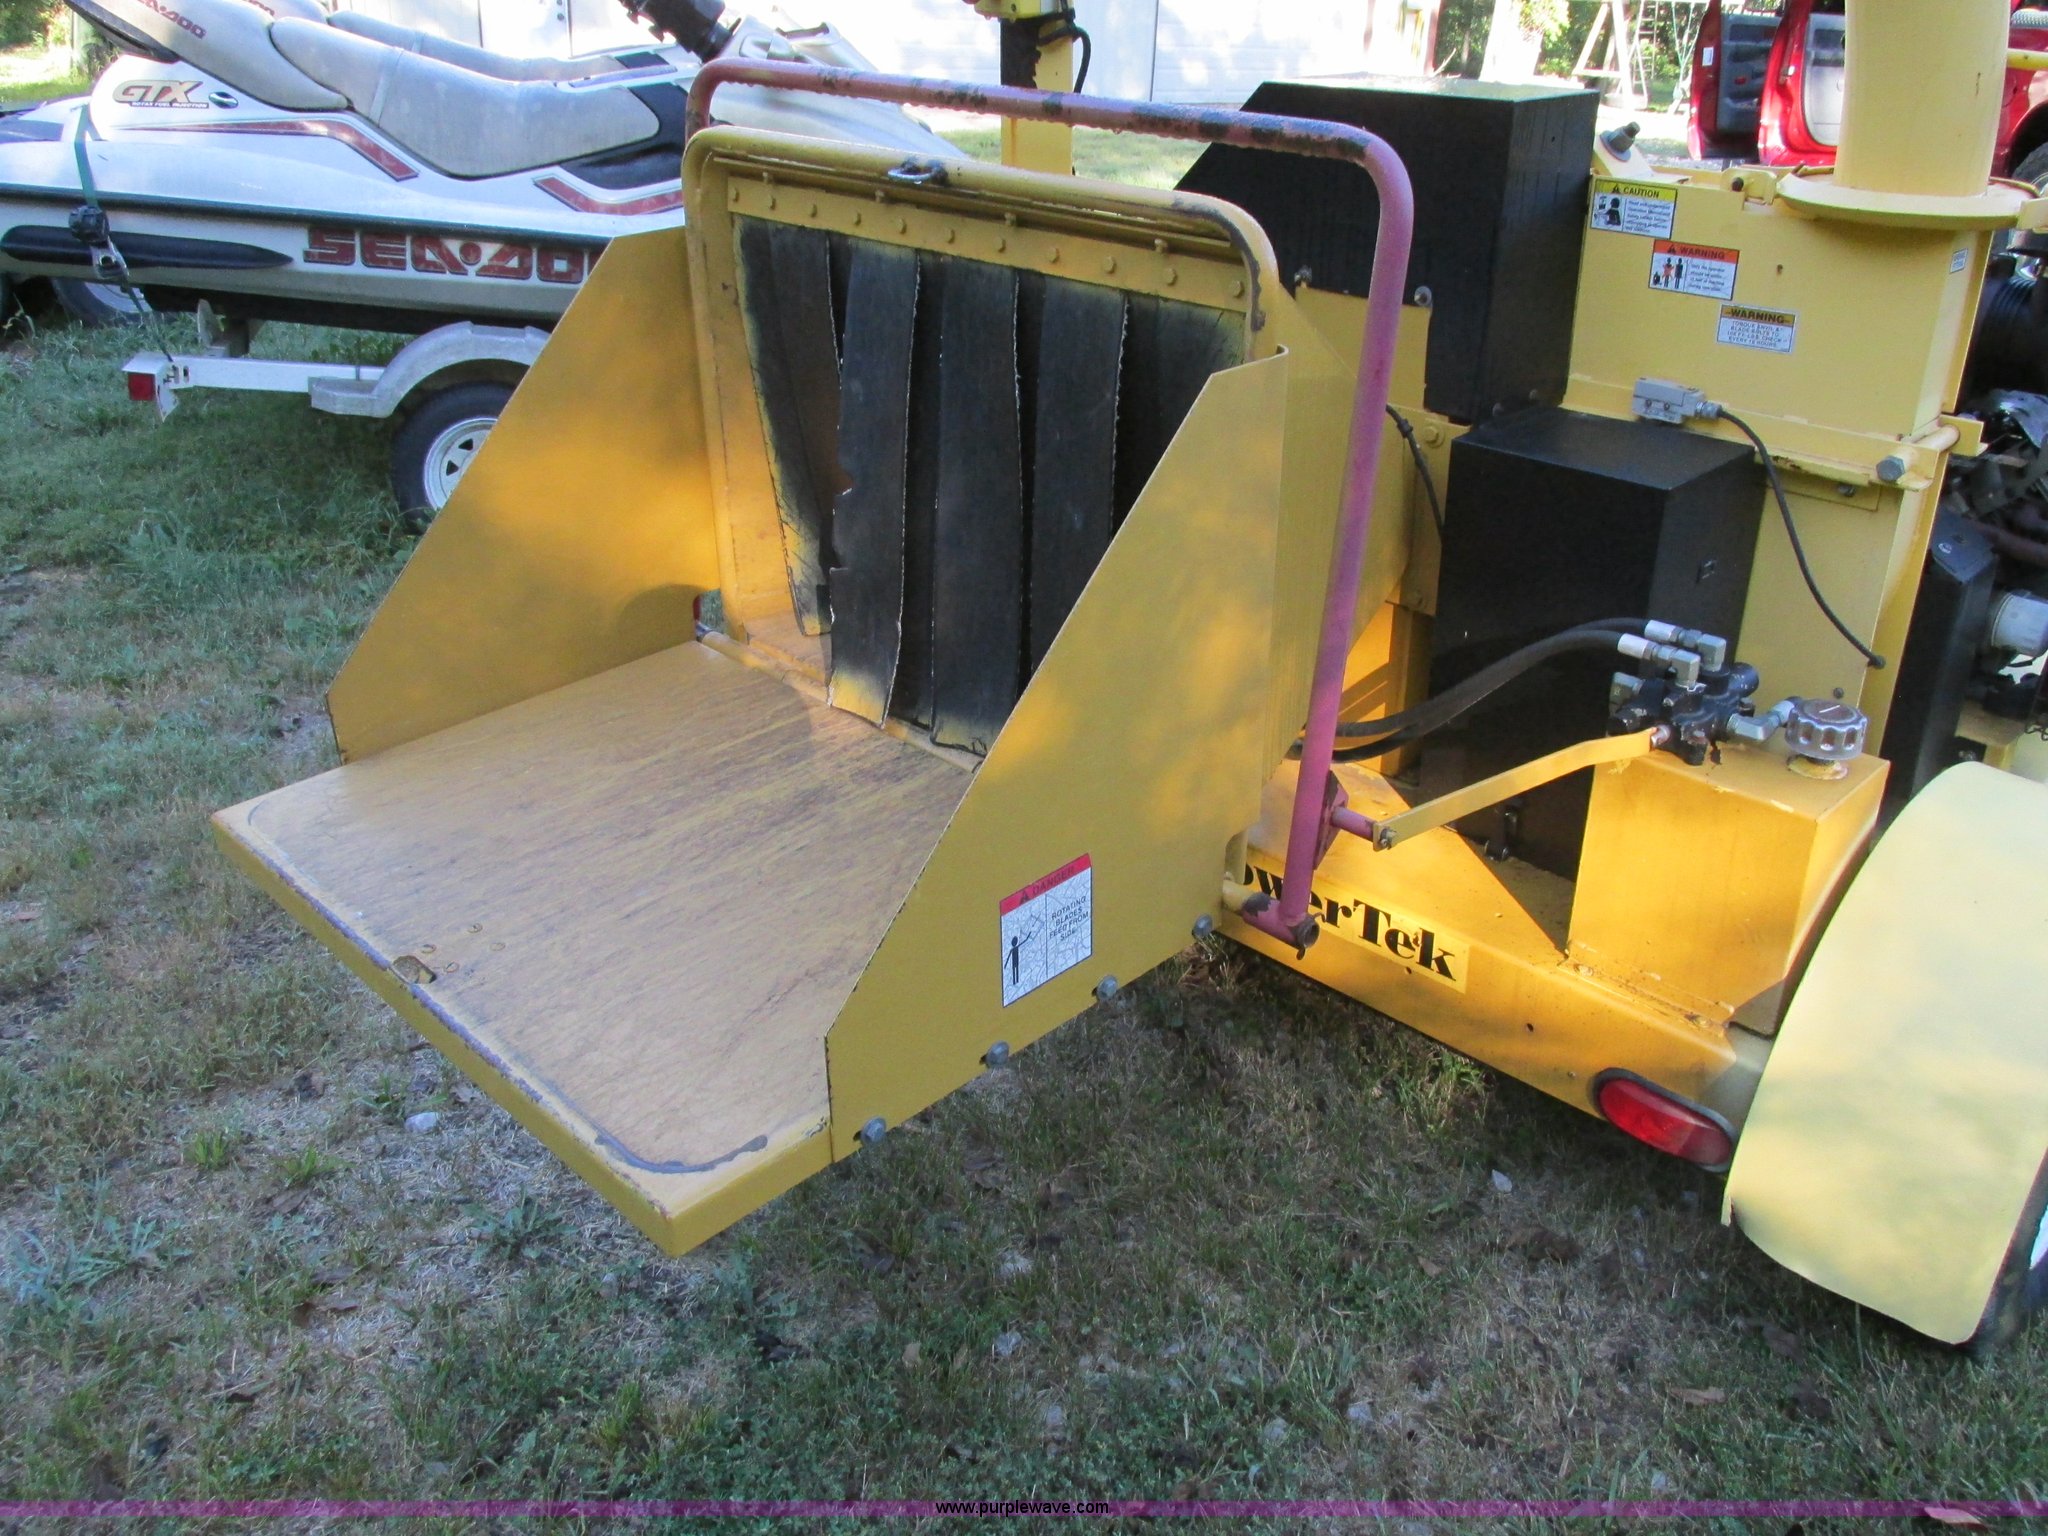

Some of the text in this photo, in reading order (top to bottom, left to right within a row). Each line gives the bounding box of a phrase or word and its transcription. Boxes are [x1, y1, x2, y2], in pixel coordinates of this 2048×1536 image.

[112, 79, 203, 104] GTX
[1623, 187, 1660, 198] CAUTION
[1680, 247, 1725, 259] WARNING
[1033, 866, 1074, 895] DANGER
[1051, 895, 1086, 920] ROTATING
[1055, 906, 1083, 926] BLADES
[1049, 911, 1089, 939] FEED FROM
[1060, 928, 1076, 941] SIDE
